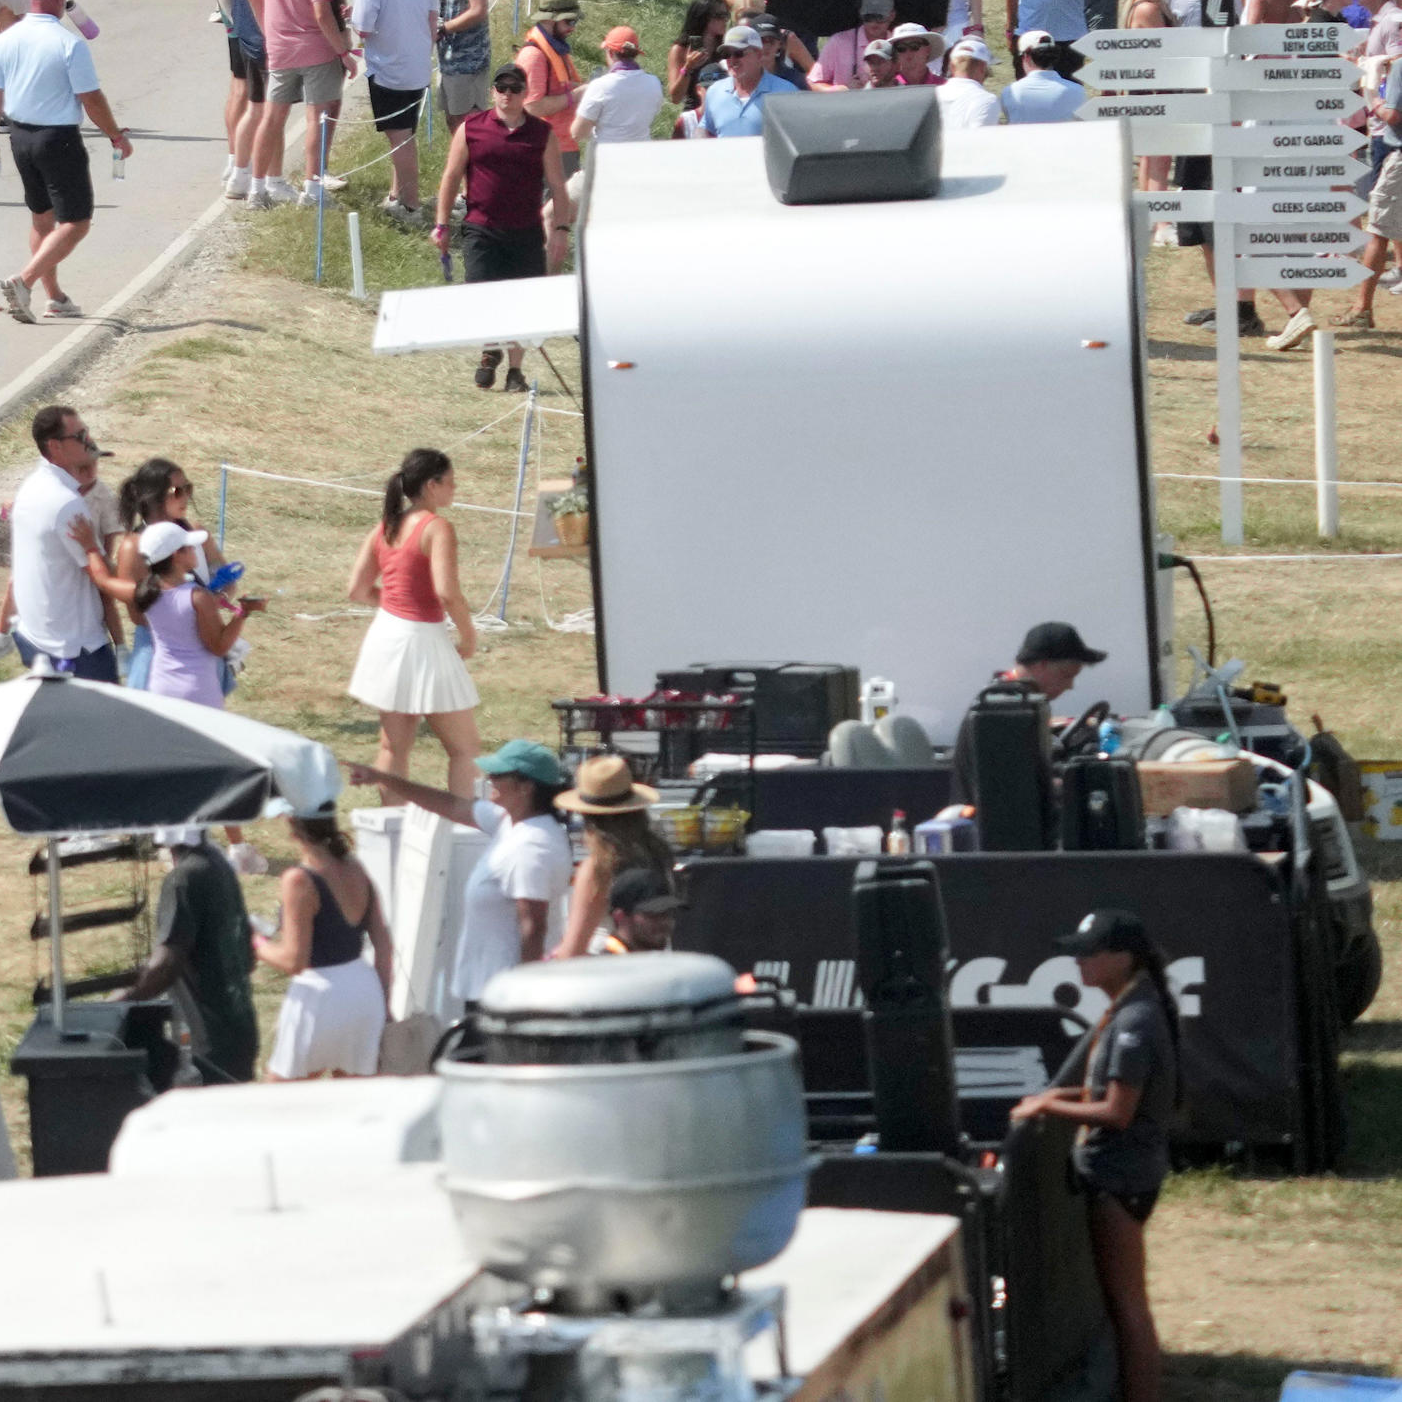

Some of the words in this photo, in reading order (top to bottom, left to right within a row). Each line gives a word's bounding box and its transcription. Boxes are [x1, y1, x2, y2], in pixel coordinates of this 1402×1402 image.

[1285, 28, 1308, 38] CLUB
[1326, 27, 1339, 40] @
[1096, 38, 1162, 50] CONCESSIONS
[1283, 42, 1305, 52] 18TH
[1307, 41, 1339, 51] GREEN
[1100, 70, 1117, 80] FAN
[1119, 69, 1156, 79] VILLAGE
[1264, 69, 1299, 79] FAMILY
[1301, 68, 1342, 79] SERVICES
[1316, 99, 1345, 110] OASIS
[1098, 105, 1166, 117] MERCHANDISE
[1273, 136, 1301, 147] GOAT
[1304, 135, 1344, 146] GARAGE
[1316, 166, 1345, 176] SUITES
[1306, 202, 1347, 213] GARDEN
[1283, 233, 1308, 243] WINE
[1310, 232, 1350, 243] GARDEN
[1280, 268, 1347, 278] CONCESSIONS
